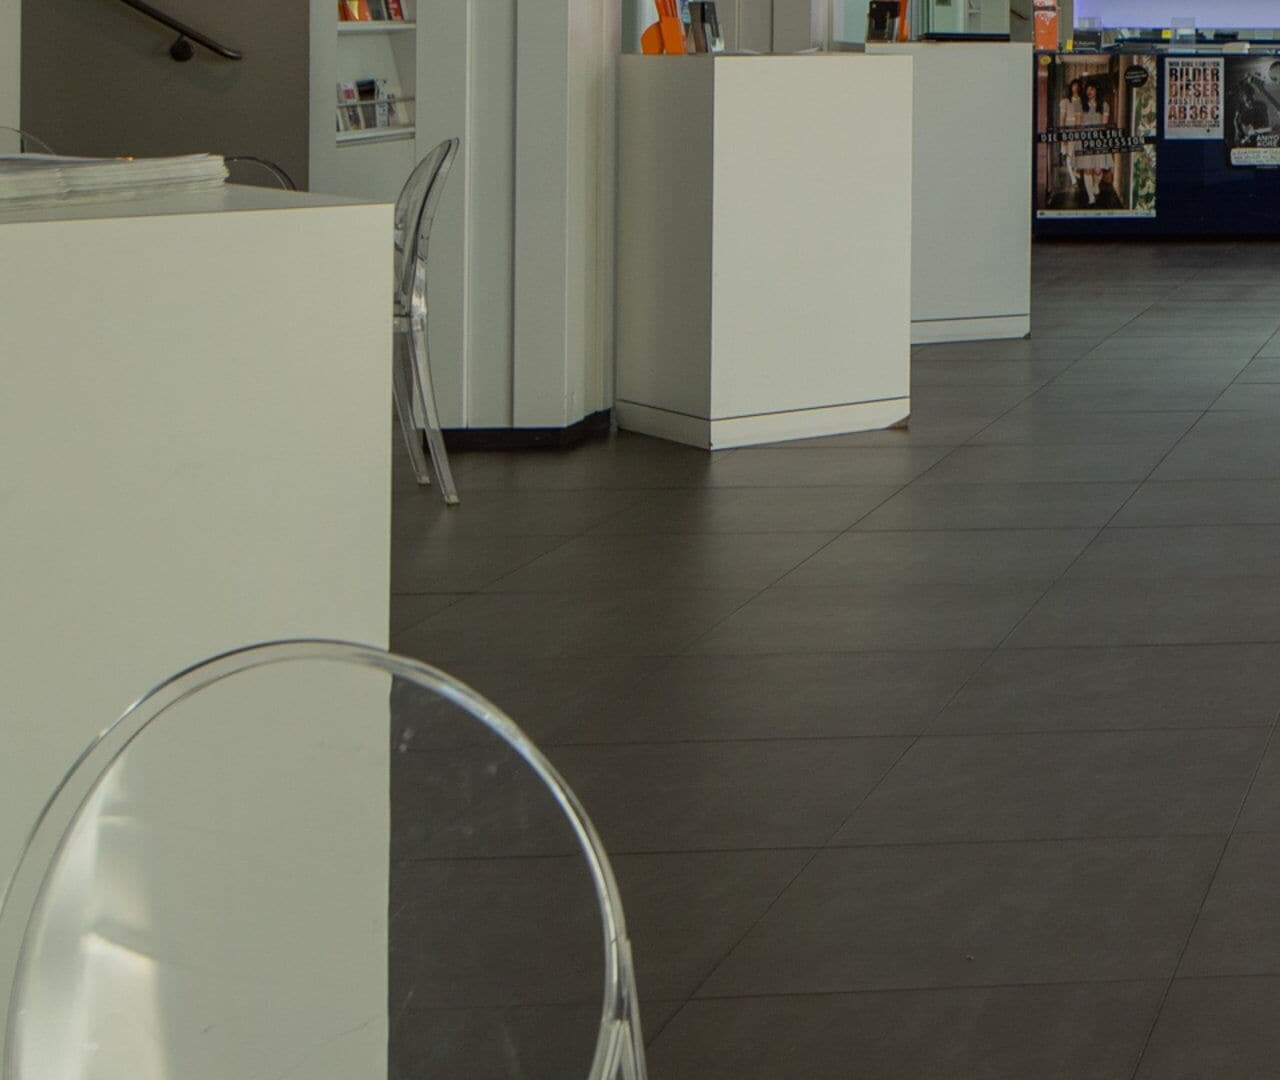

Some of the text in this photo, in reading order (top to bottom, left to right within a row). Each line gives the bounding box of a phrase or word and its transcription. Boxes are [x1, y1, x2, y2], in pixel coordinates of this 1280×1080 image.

[1169, 67, 1219, 82] BILDER
[1169, 83, 1219, 97] DIESER
[1168, 105, 1187, 120] AB
[1189, 105, 1208, 120] 36
[1041, 129, 1124, 142] DIE BORDERLINE
[1083, 137, 1145, 148] PROZESSION
